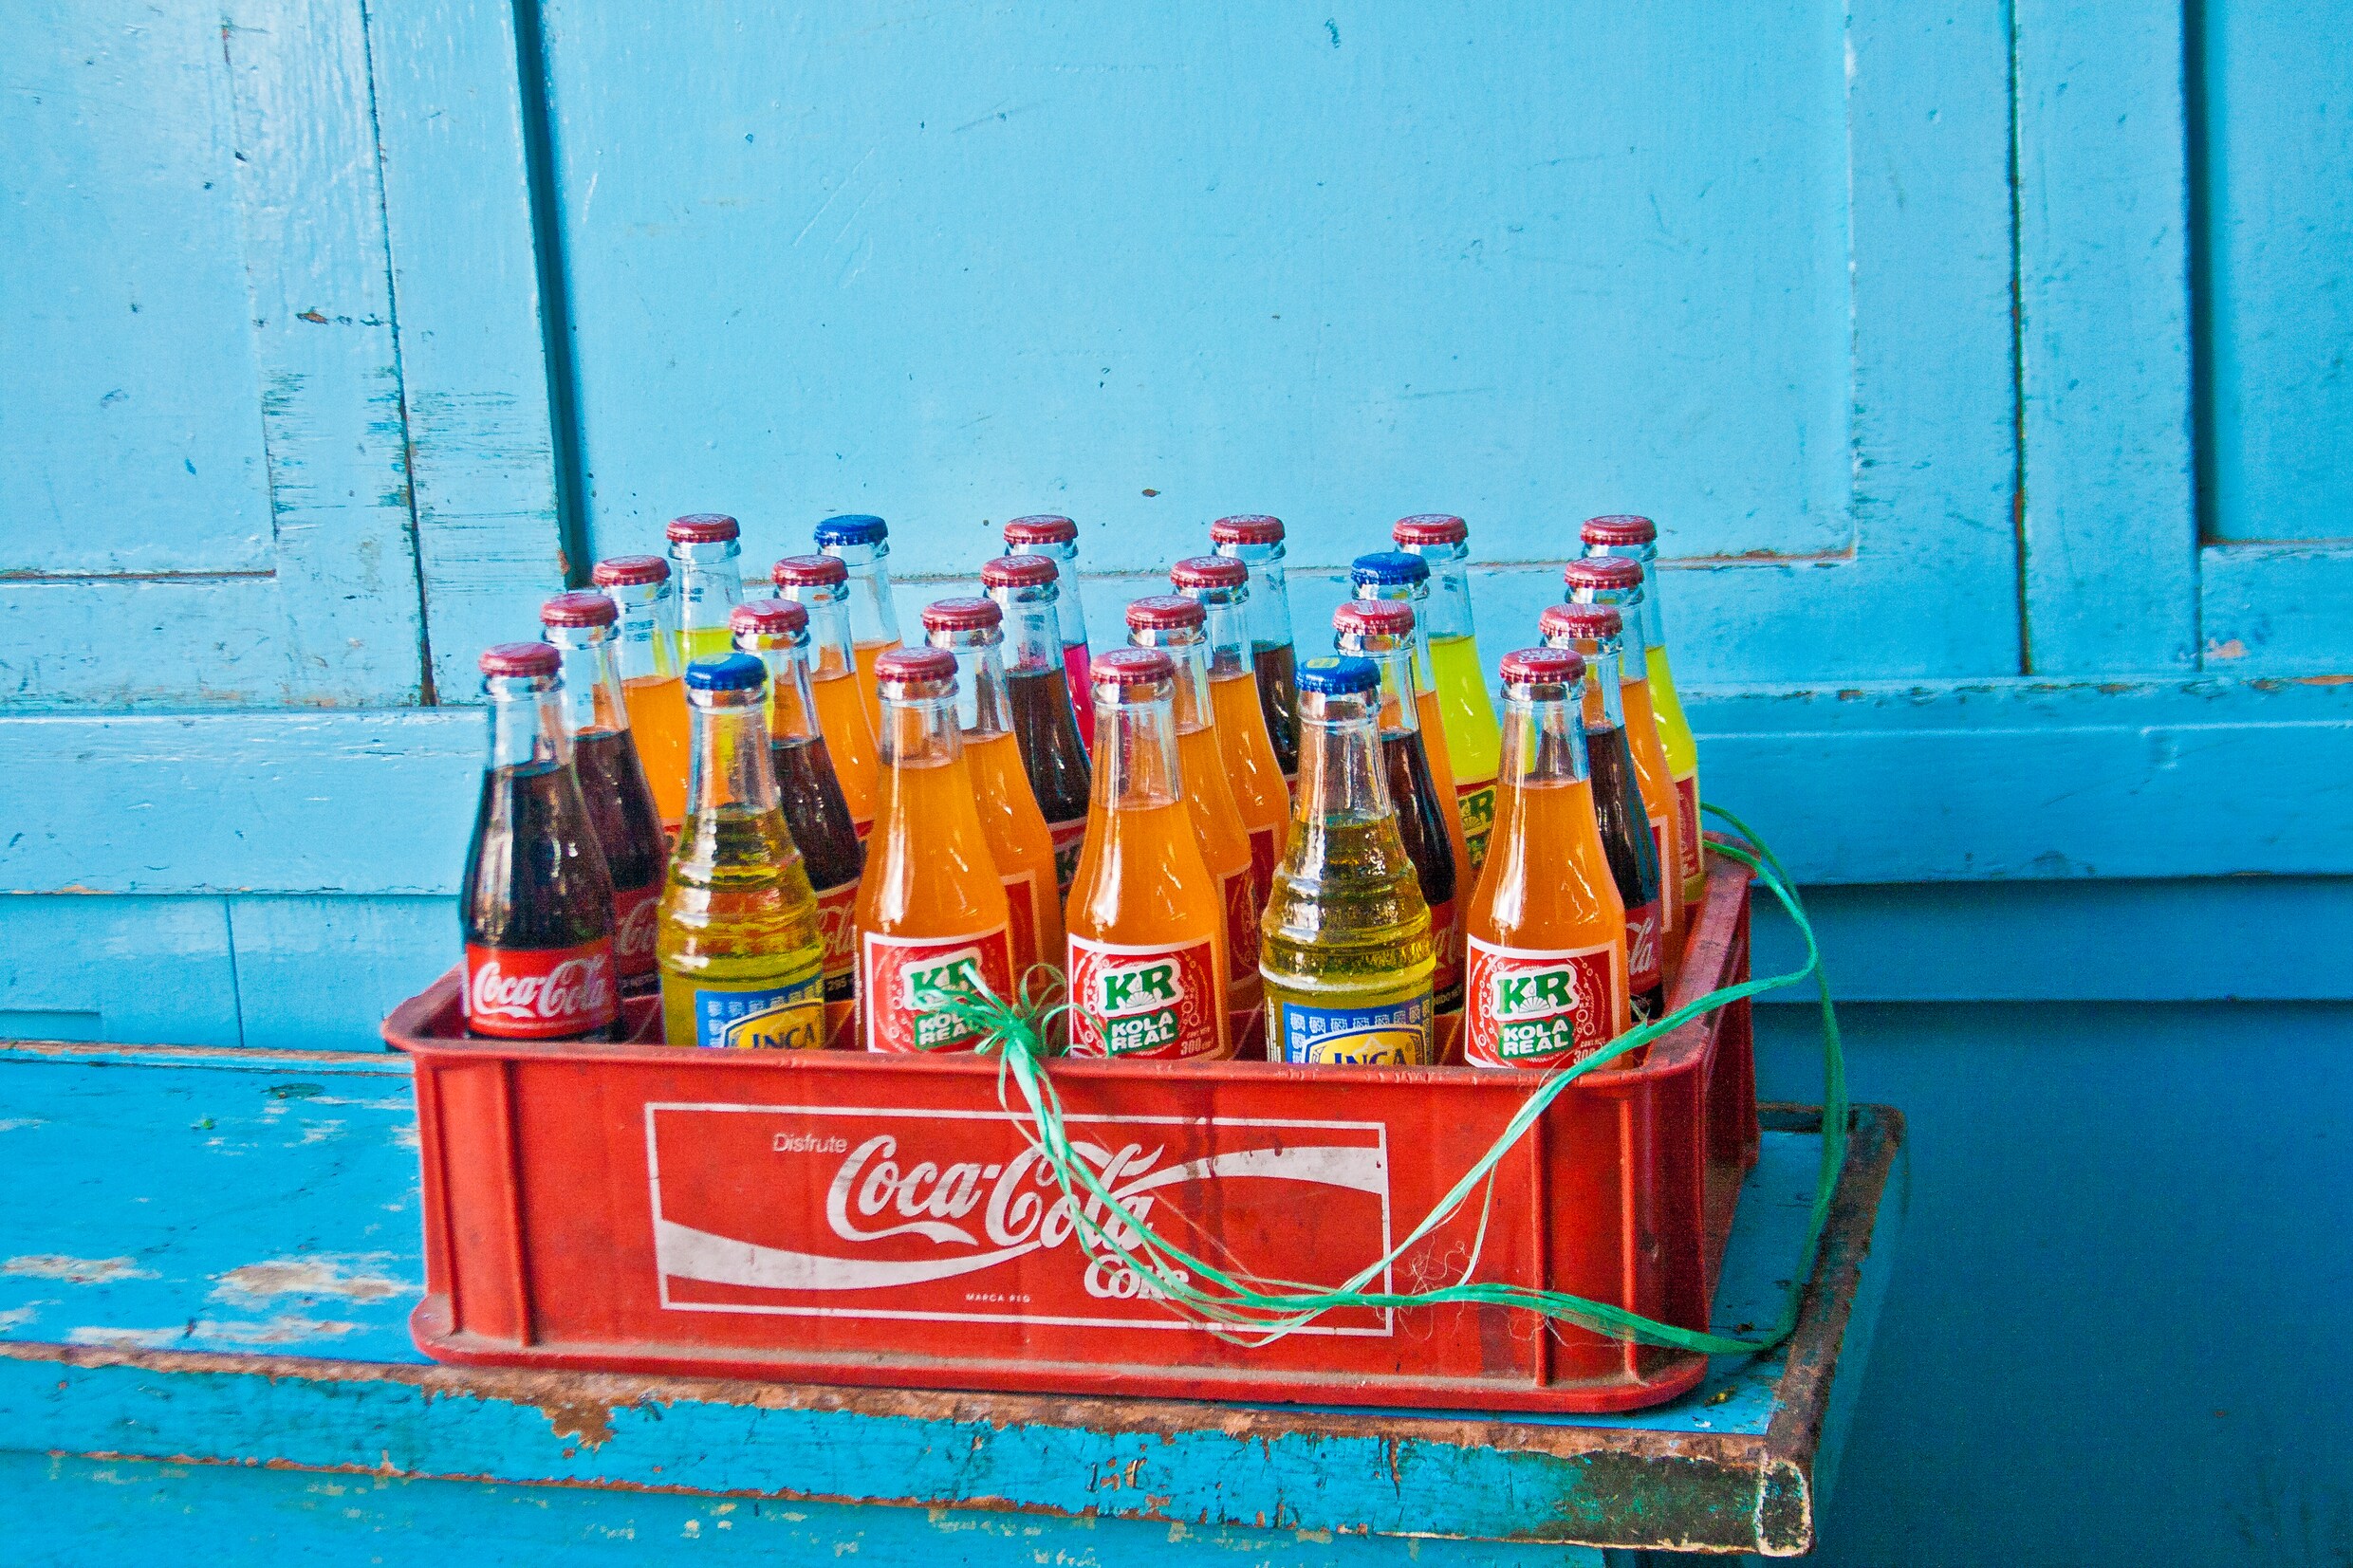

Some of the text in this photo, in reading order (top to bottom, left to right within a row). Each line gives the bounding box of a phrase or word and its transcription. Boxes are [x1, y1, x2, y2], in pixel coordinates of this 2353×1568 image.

[472, 954, 608, 1018] Coca-Cola
[1104, 965, 1176, 1010] KR
[1497, 970, 1573, 1014] KR
[918, 1012, 965, 1033] KOL
[919, 1023, 969, 1045] REA
[1112, 1012, 1173, 1038] KOLA
[1504, 1019, 1568, 1042] KOLA
[1111, 1026, 1175, 1051] REAL
[1180, 1037, 1202, 1055] 300
[1504, 1034, 1568, 1056] REAL
[772, 1133, 848, 1154] Disfrute
[827, 1134, 1164, 1249] Coca-Cola
[966, 1292, 1005, 1302] MARCA
